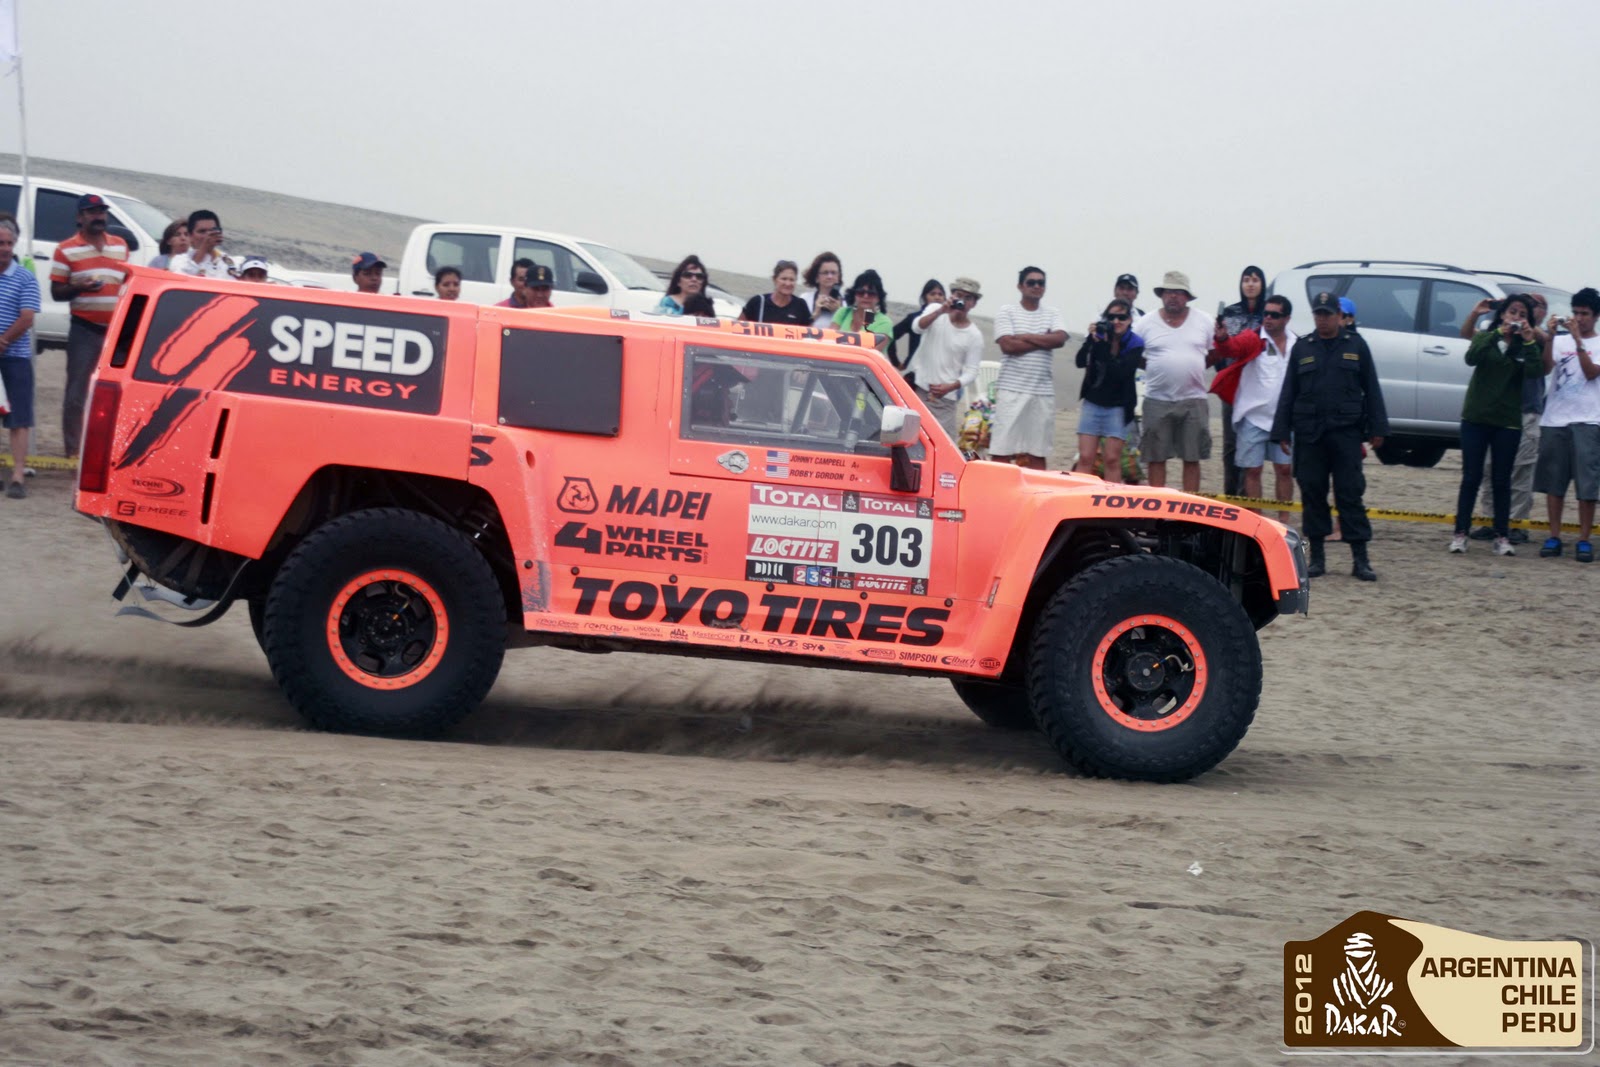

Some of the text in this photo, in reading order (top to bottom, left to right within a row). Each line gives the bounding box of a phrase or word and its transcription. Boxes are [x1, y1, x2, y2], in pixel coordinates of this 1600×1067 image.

[268, 315, 434, 376] SPEED
[270, 368, 418, 399] ENERGY
[790, 455, 813, 464] JOHNNY
[815, 457, 846, 467] CAMPBELL
[790, 469, 813, 478] ROBBY
[815, 471, 845, 480] GORDON
[605, 485, 712, 520] MAPEI
[753, 485, 838, 509] TOTAL
[861, 497, 915, 513] TOTAL
[1091, 494, 1162, 511] TOYO
[1166, 500, 1240, 521] TIRES
[751, 514, 837, 529] www.dakar.com
[554, 521, 603, 555] 4
[605, 524, 708, 548] WHEEL
[851, 523, 923, 568] 303
[605, 541, 702, 564] PARTS
[751, 537, 834, 559] LOCTITE
[796, 570, 832, 584] 2 3 4
[572, 576, 951, 647] TOYO TIRES
[692, 631, 736, 641] MasterCraft
[802, 642, 817, 650] SPY
[899, 652, 938, 663] SIMPSON
